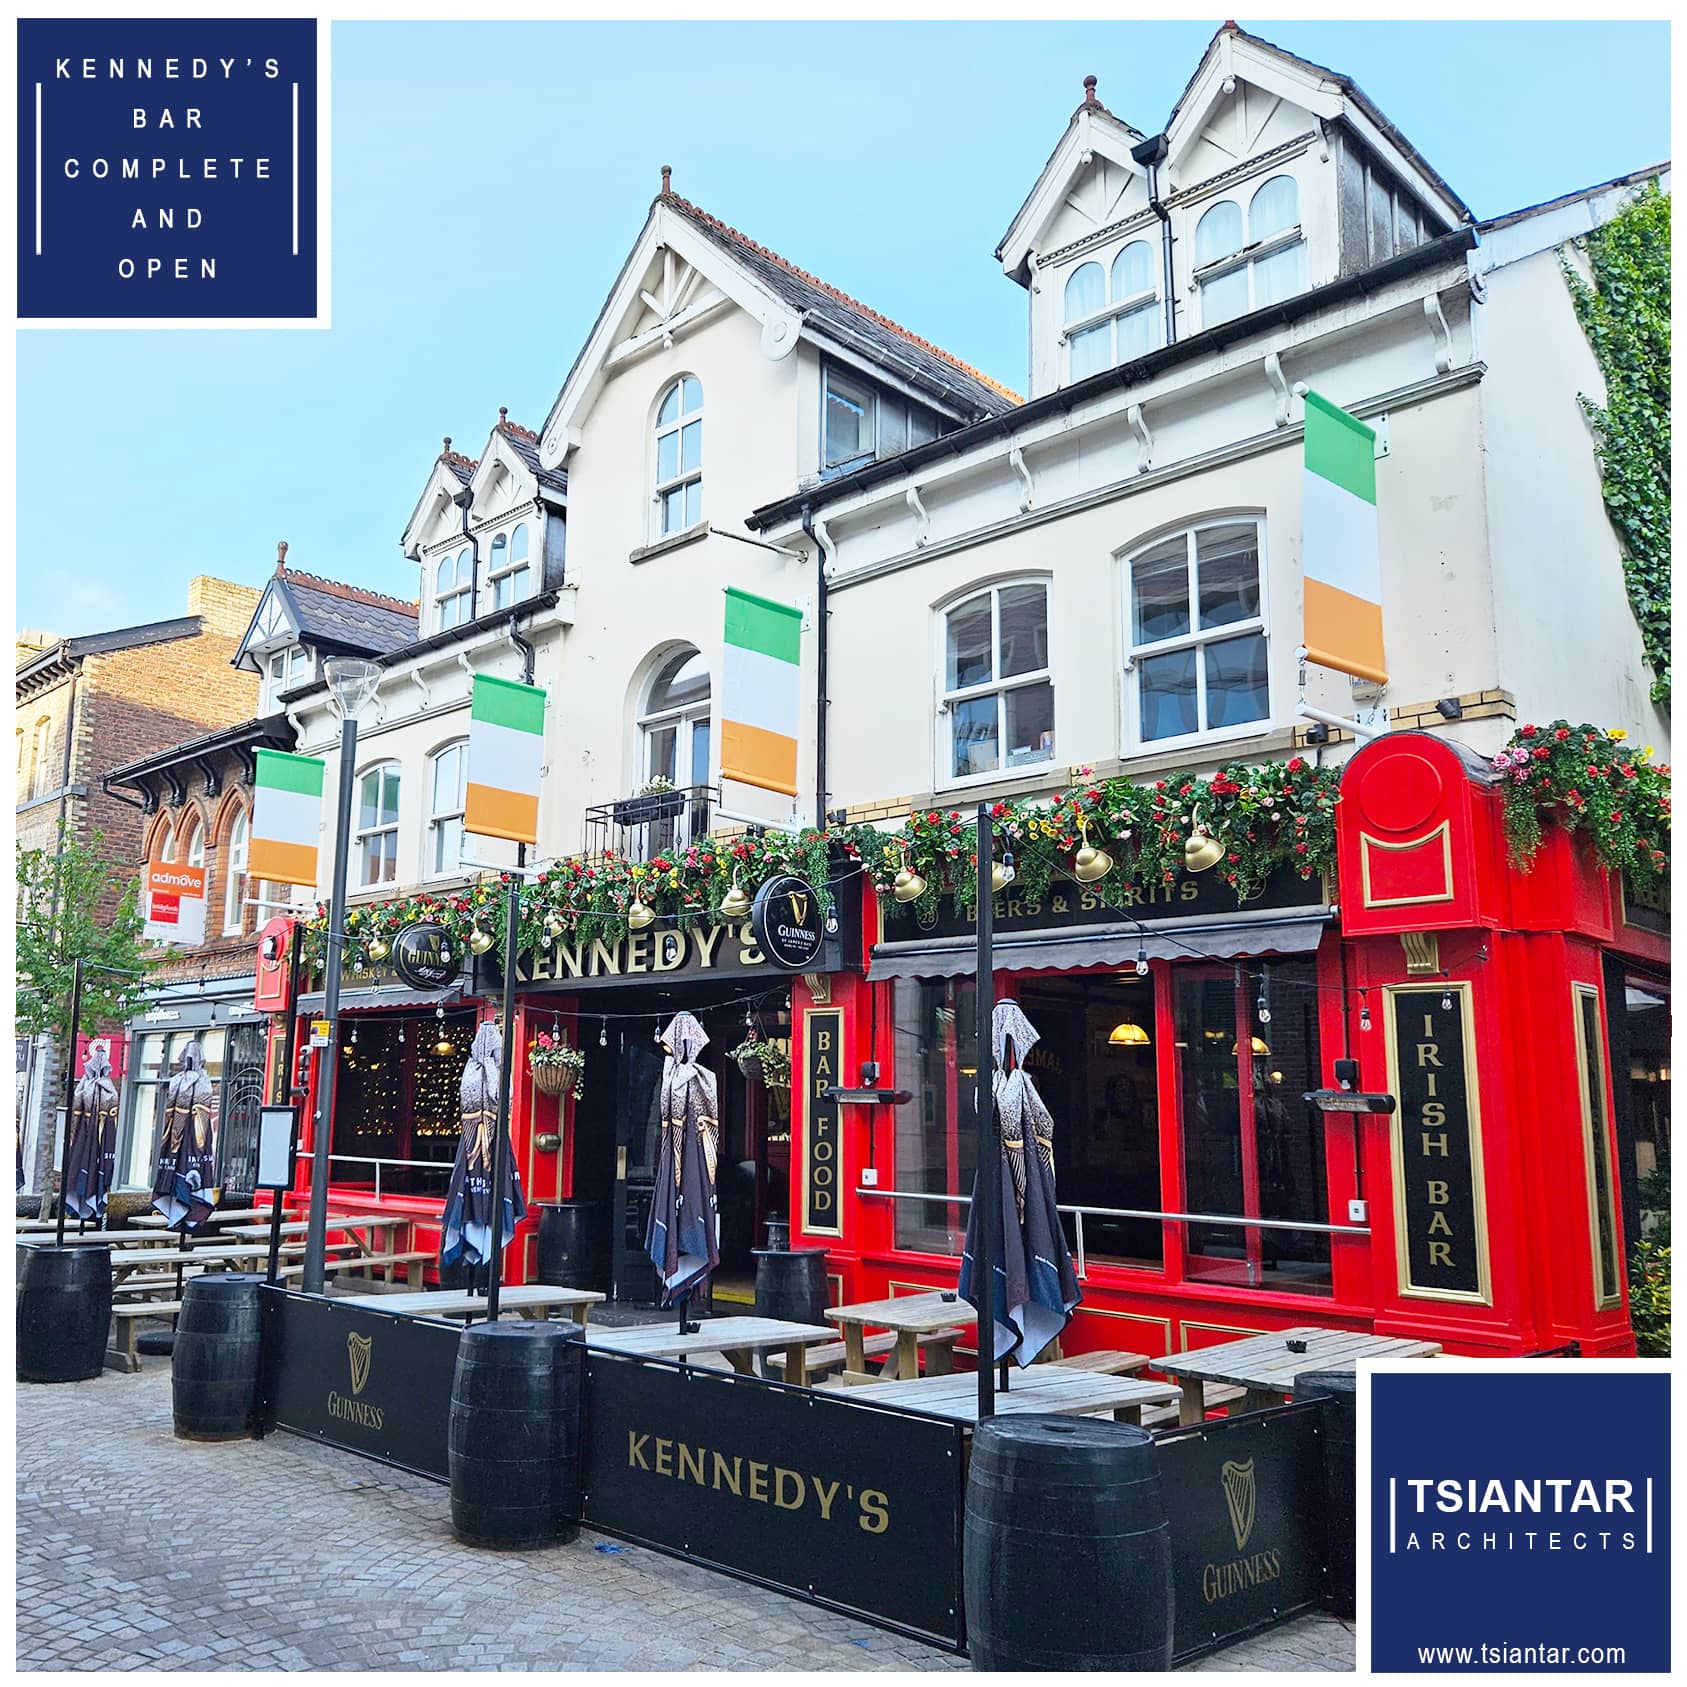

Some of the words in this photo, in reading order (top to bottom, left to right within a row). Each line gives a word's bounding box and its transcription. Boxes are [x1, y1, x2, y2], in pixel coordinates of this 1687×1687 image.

[966, 898, 1042, 922] BERS
[1052, 896, 1069, 913] &
[1080, 880, 1199, 911] SRITS
[407, 949, 452, 968] GUINN
[777, 924, 816, 942] GUINNESS
[276, 1050, 285, 1103] IRIS
[1416, 1014, 1451, 1157] IRISH
[813, 1117, 833, 1211] FOOD
[1427, 1180, 1456, 1267] BAR
[328, 1390, 385, 1430] GUINNESS
[628, 1430, 890, 1534] KENNEDY'S
[1203, 1548, 1281, 1603] GUINNESS
